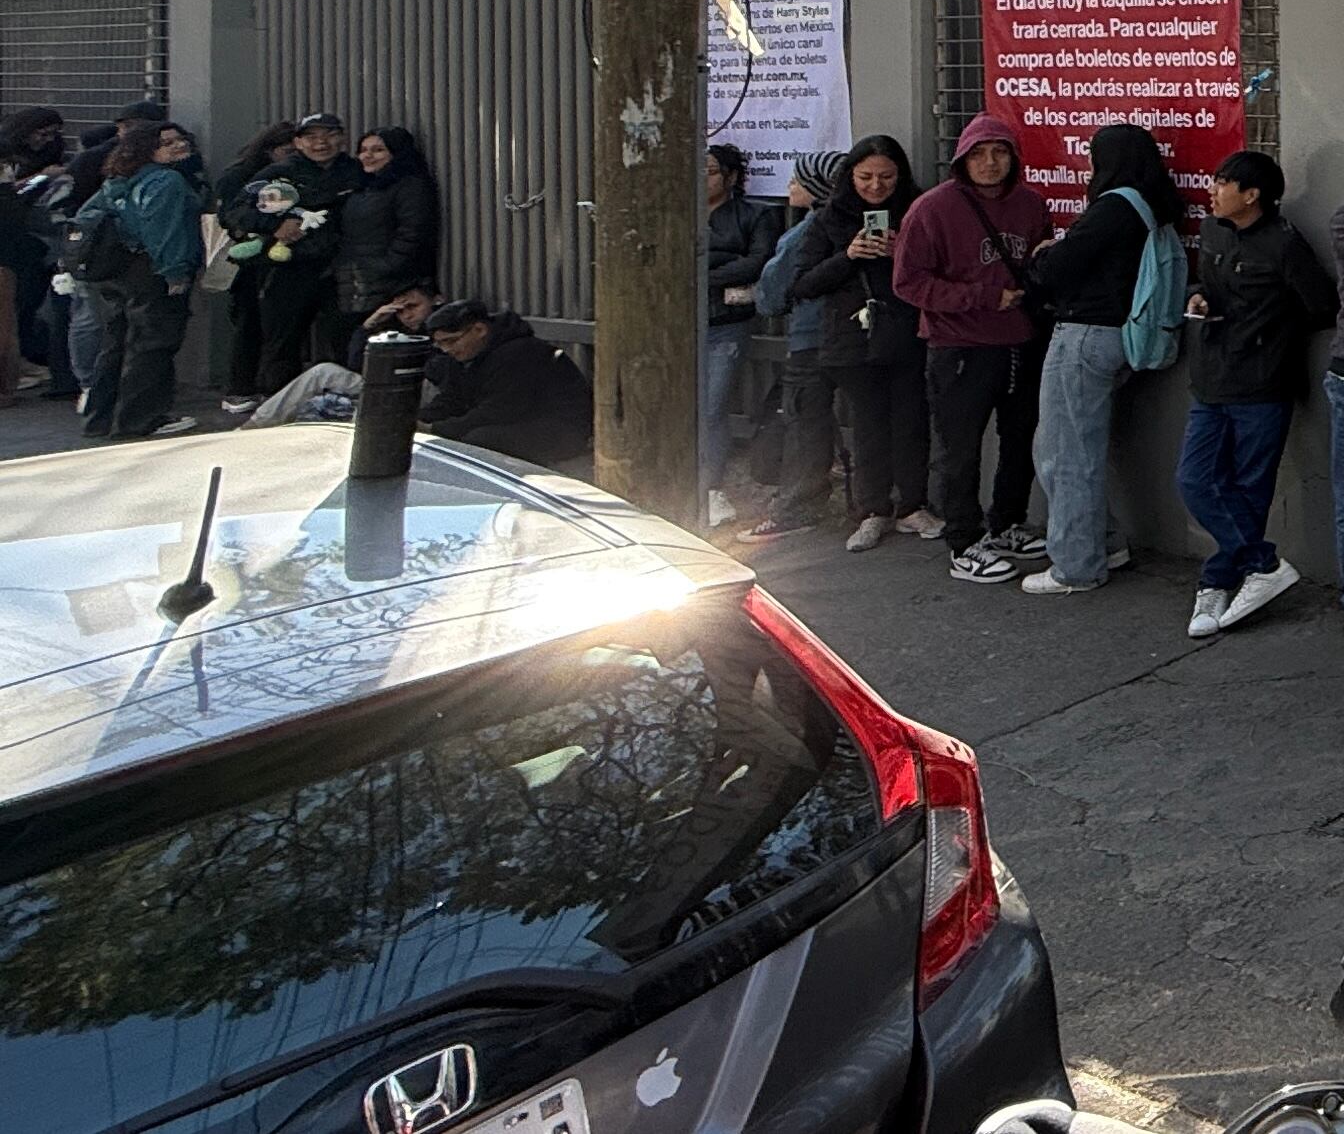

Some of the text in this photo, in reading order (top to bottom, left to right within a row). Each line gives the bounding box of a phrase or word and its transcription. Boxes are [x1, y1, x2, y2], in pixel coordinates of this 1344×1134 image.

[776, 7, 800, 20] Harry
[802, 5, 830, 18] Styles
[784, 24, 798, 33] en
[1012, 16, 1218, 40] trará cerrada. Para cualquier
[797, 36, 824, 48] canal
[720, 58, 740, 70] para
[779, 55, 793, 65] de
[998, 46, 1236, 72] compra de boletos de eventos de
[713, 88, 725, 98] de
[995, 77, 1240, 101] OCESA, la podrás realizar a través
[758, 120, 772, 129] en
[1024, 107, 1216, 130] de los canales digitales de
[1025, 165, 1075, 187] taquilla
